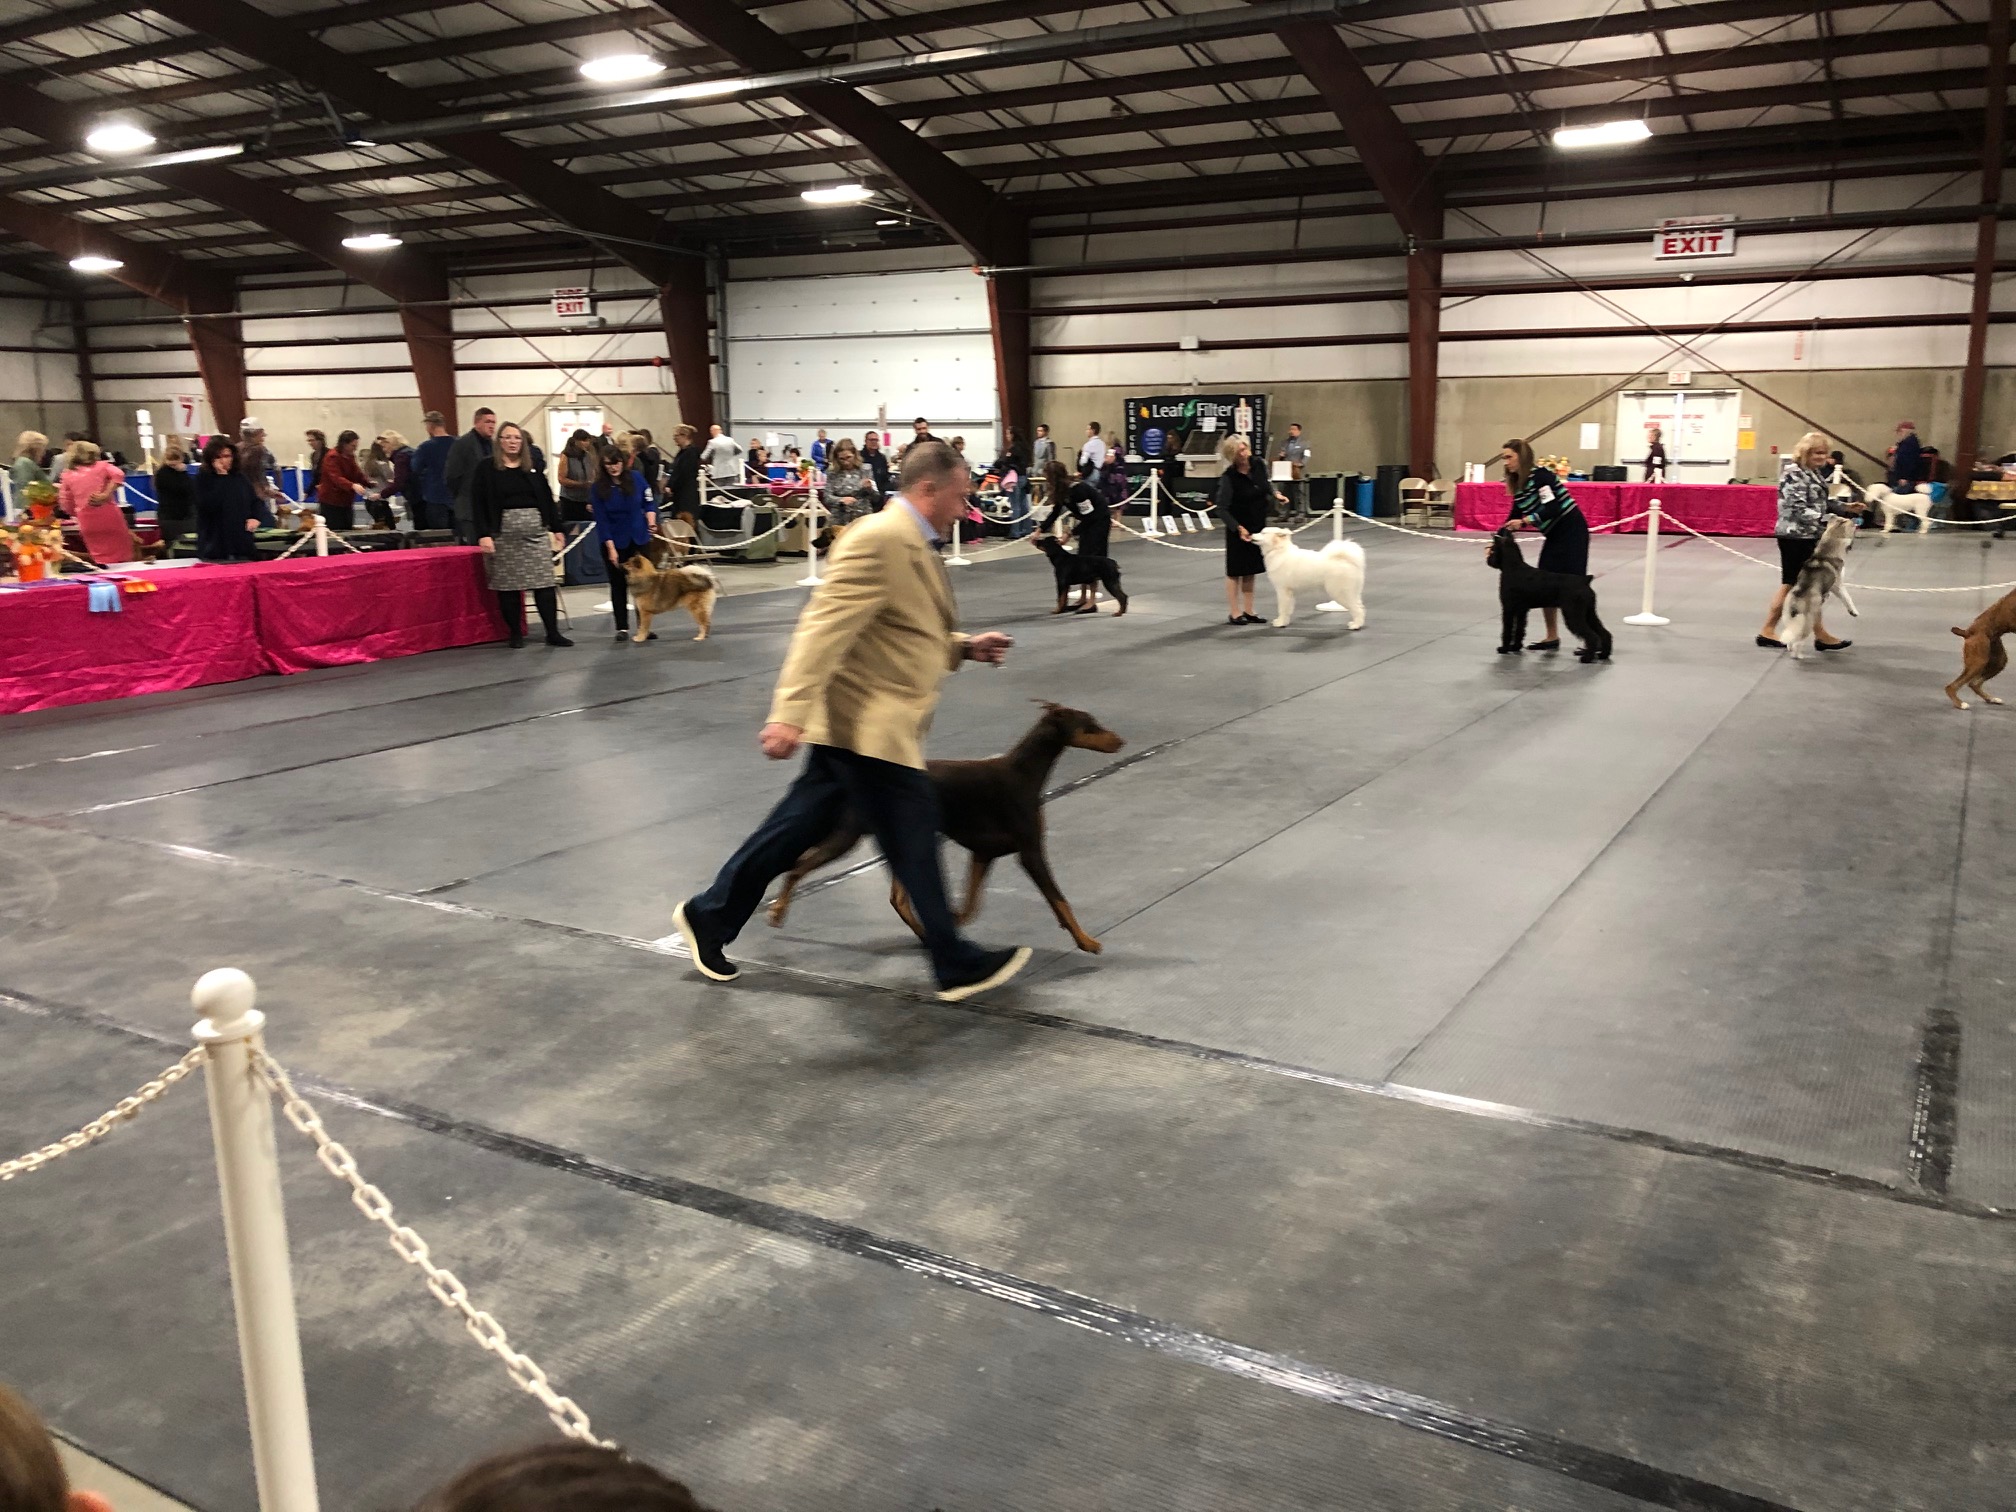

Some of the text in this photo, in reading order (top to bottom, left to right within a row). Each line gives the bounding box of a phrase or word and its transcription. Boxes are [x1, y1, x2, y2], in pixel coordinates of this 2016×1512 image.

[1663, 236, 1723, 254] EXIT
[557, 302, 583, 313] EXIT
[182, 404, 193, 427] 7
[1152, 403, 1232, 417] Leaf Filter
